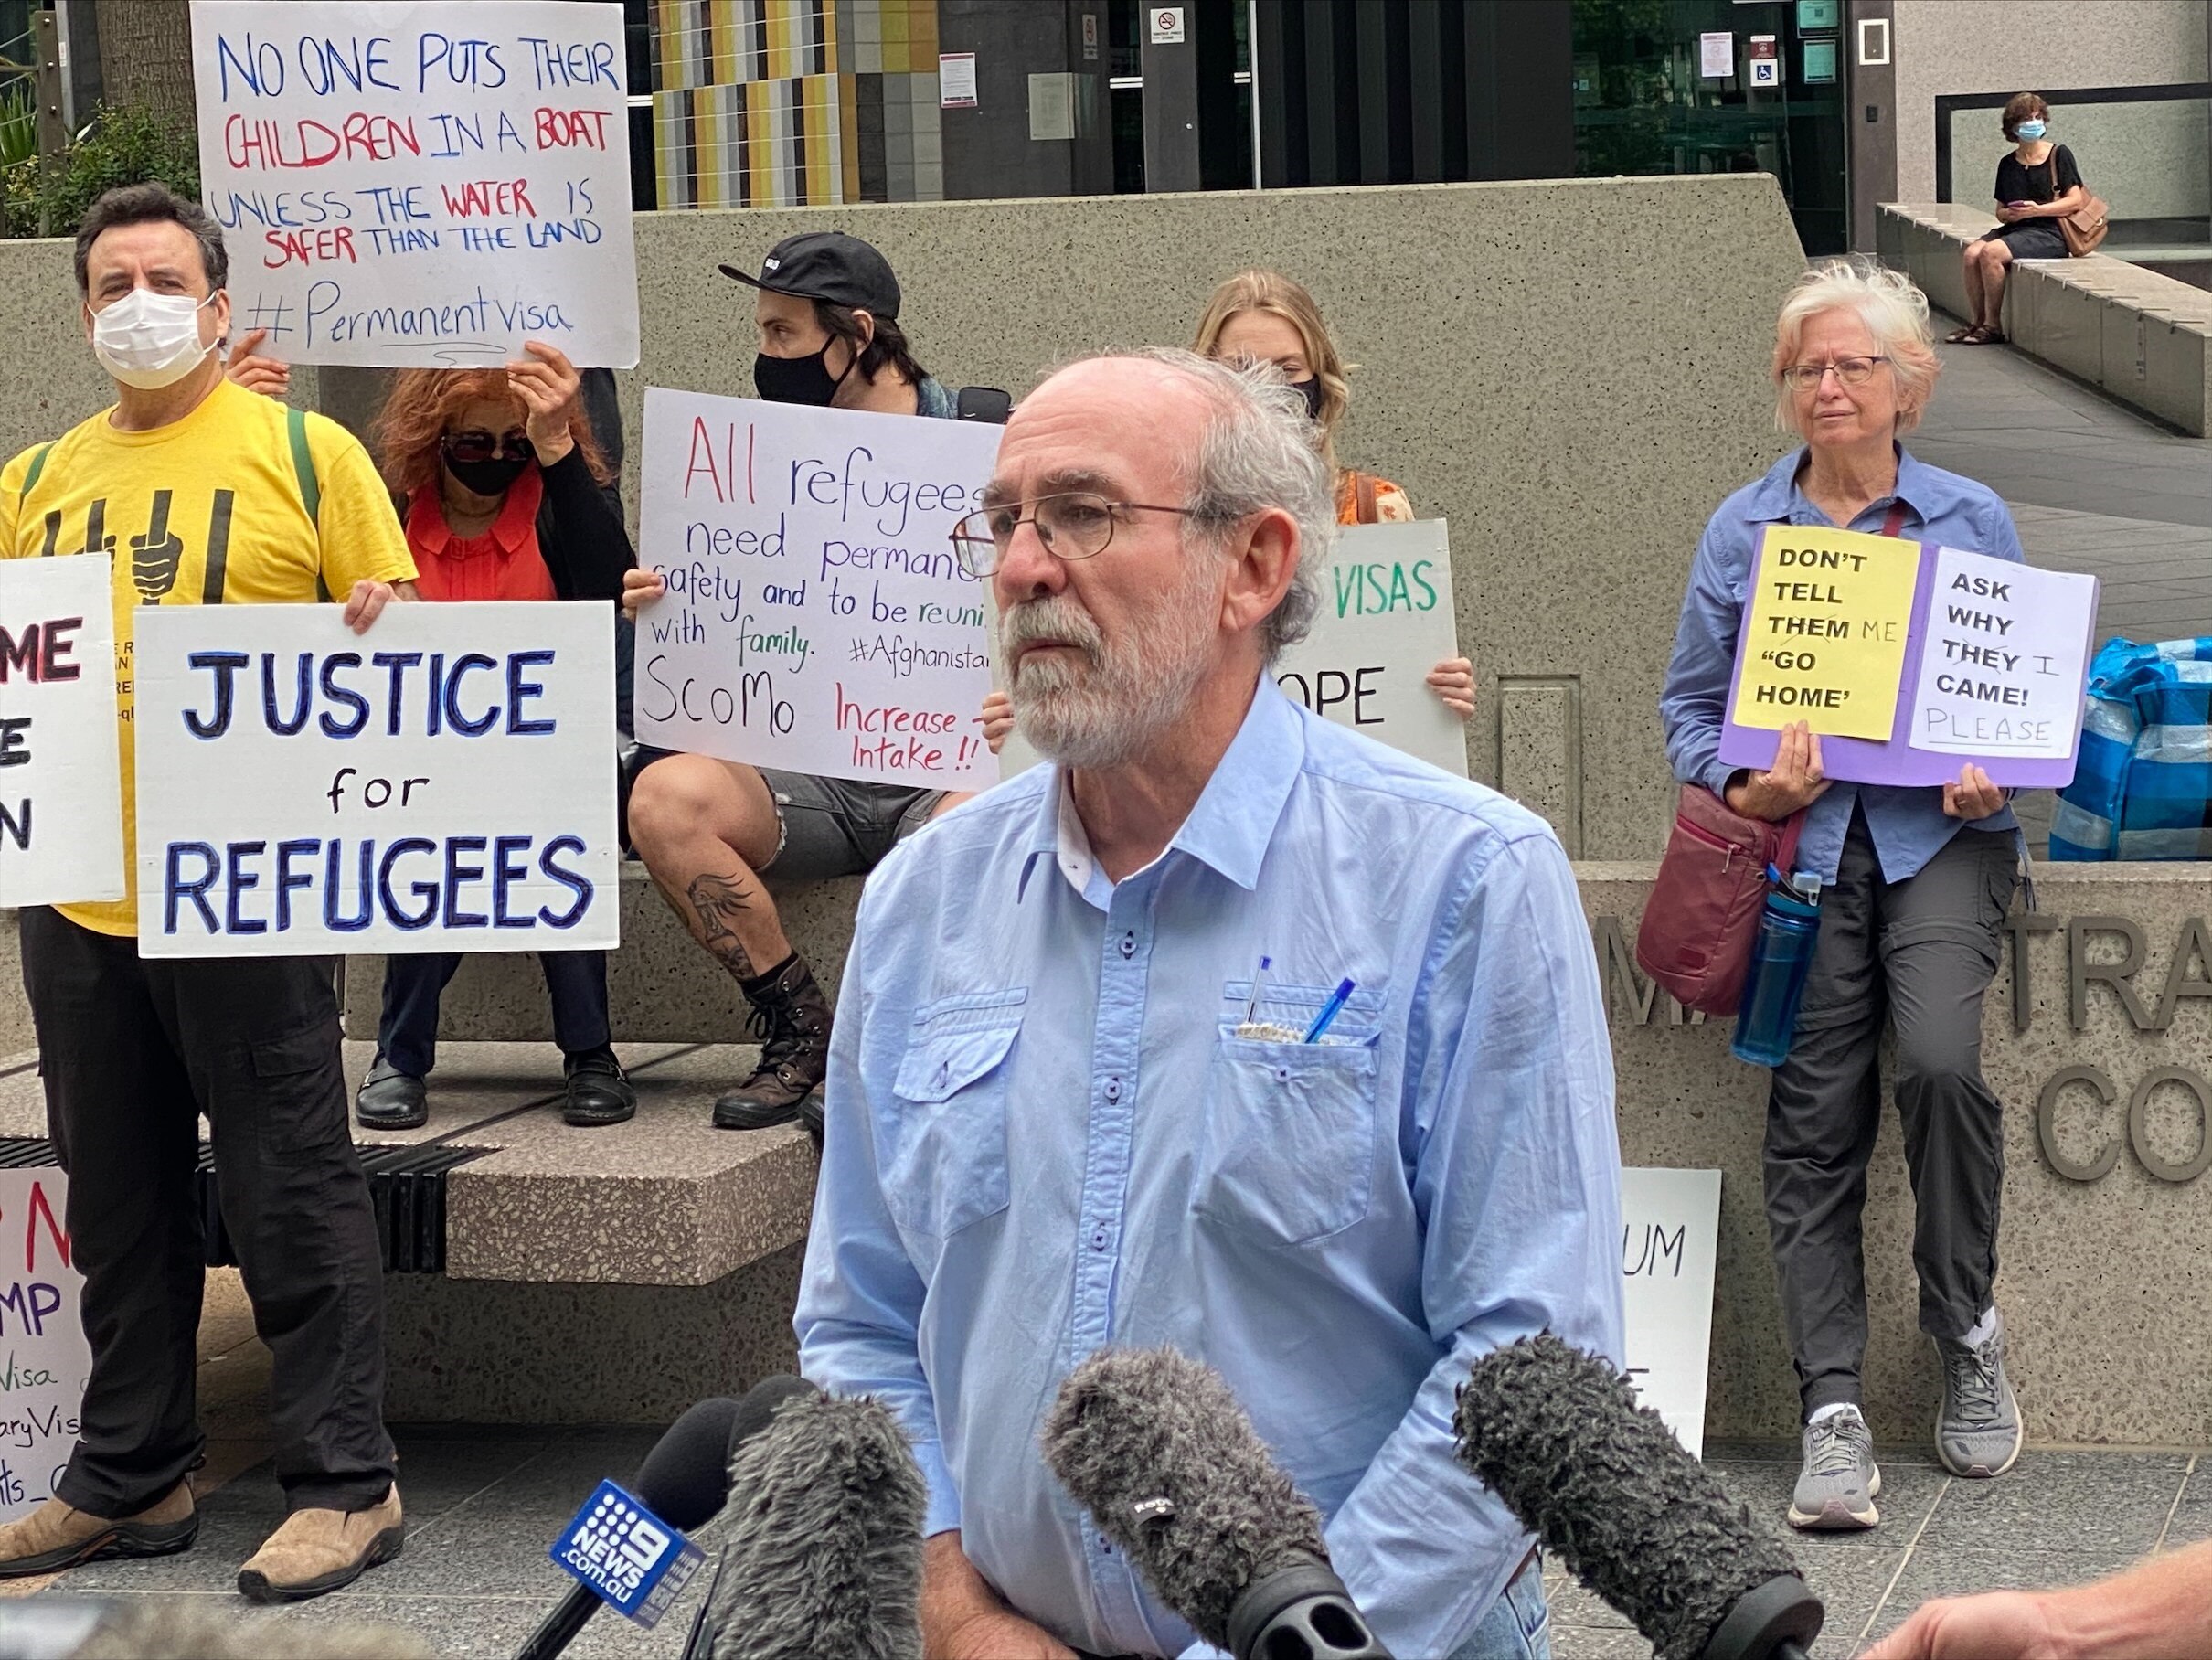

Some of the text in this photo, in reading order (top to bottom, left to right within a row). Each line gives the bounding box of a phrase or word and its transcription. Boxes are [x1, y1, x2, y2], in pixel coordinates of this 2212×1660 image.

[218, 31, 620, 101] NO ONE PUTS THEIR
[225, 107, 613, 171] CHILDREN IN A BOAT
[211, 178, 593, 229] UNLESS THE WATER IS
[263, 218, 602, 269] SAFER THAN THE LAND
[685, 416, 755, 504] All
[686, 512, 982, 583] need permane
[763, 579, 806, 607] and
[828, 577, 856, 615] to
[872, 580, 908, 623] be
[919, 603, 986, 628] reuni
[1334, 559, 1438, 619] VISAS
[1774, 582, 1843, 604] TELL
[1951, 572, 2011, 602] ASK
[651, 608, 705, 644] with
[736, 614, 815, 674] family.
[1768, 616, 1898, 643] THEM ME
[1947, 604, 2015, 636] WHY
[1942, 639, 2060, 676] THEY I
[181, 650, 557, 741] JUSTICE
[835, 682, 957, 732] Increase
[1936, 674, 2029, 707] CAME!
[1927, 708, 2052, 742] PLEASE
[853, 735, 944, 771] Intake
[327, 768, 430, 814] for
[164, 835, 595, 936] REFUGEES
[570, 1526, 645, 1590] NEWS
[620, 1519, 671, 1571] 9
[561, 1549, 633, 1604] .com.au
